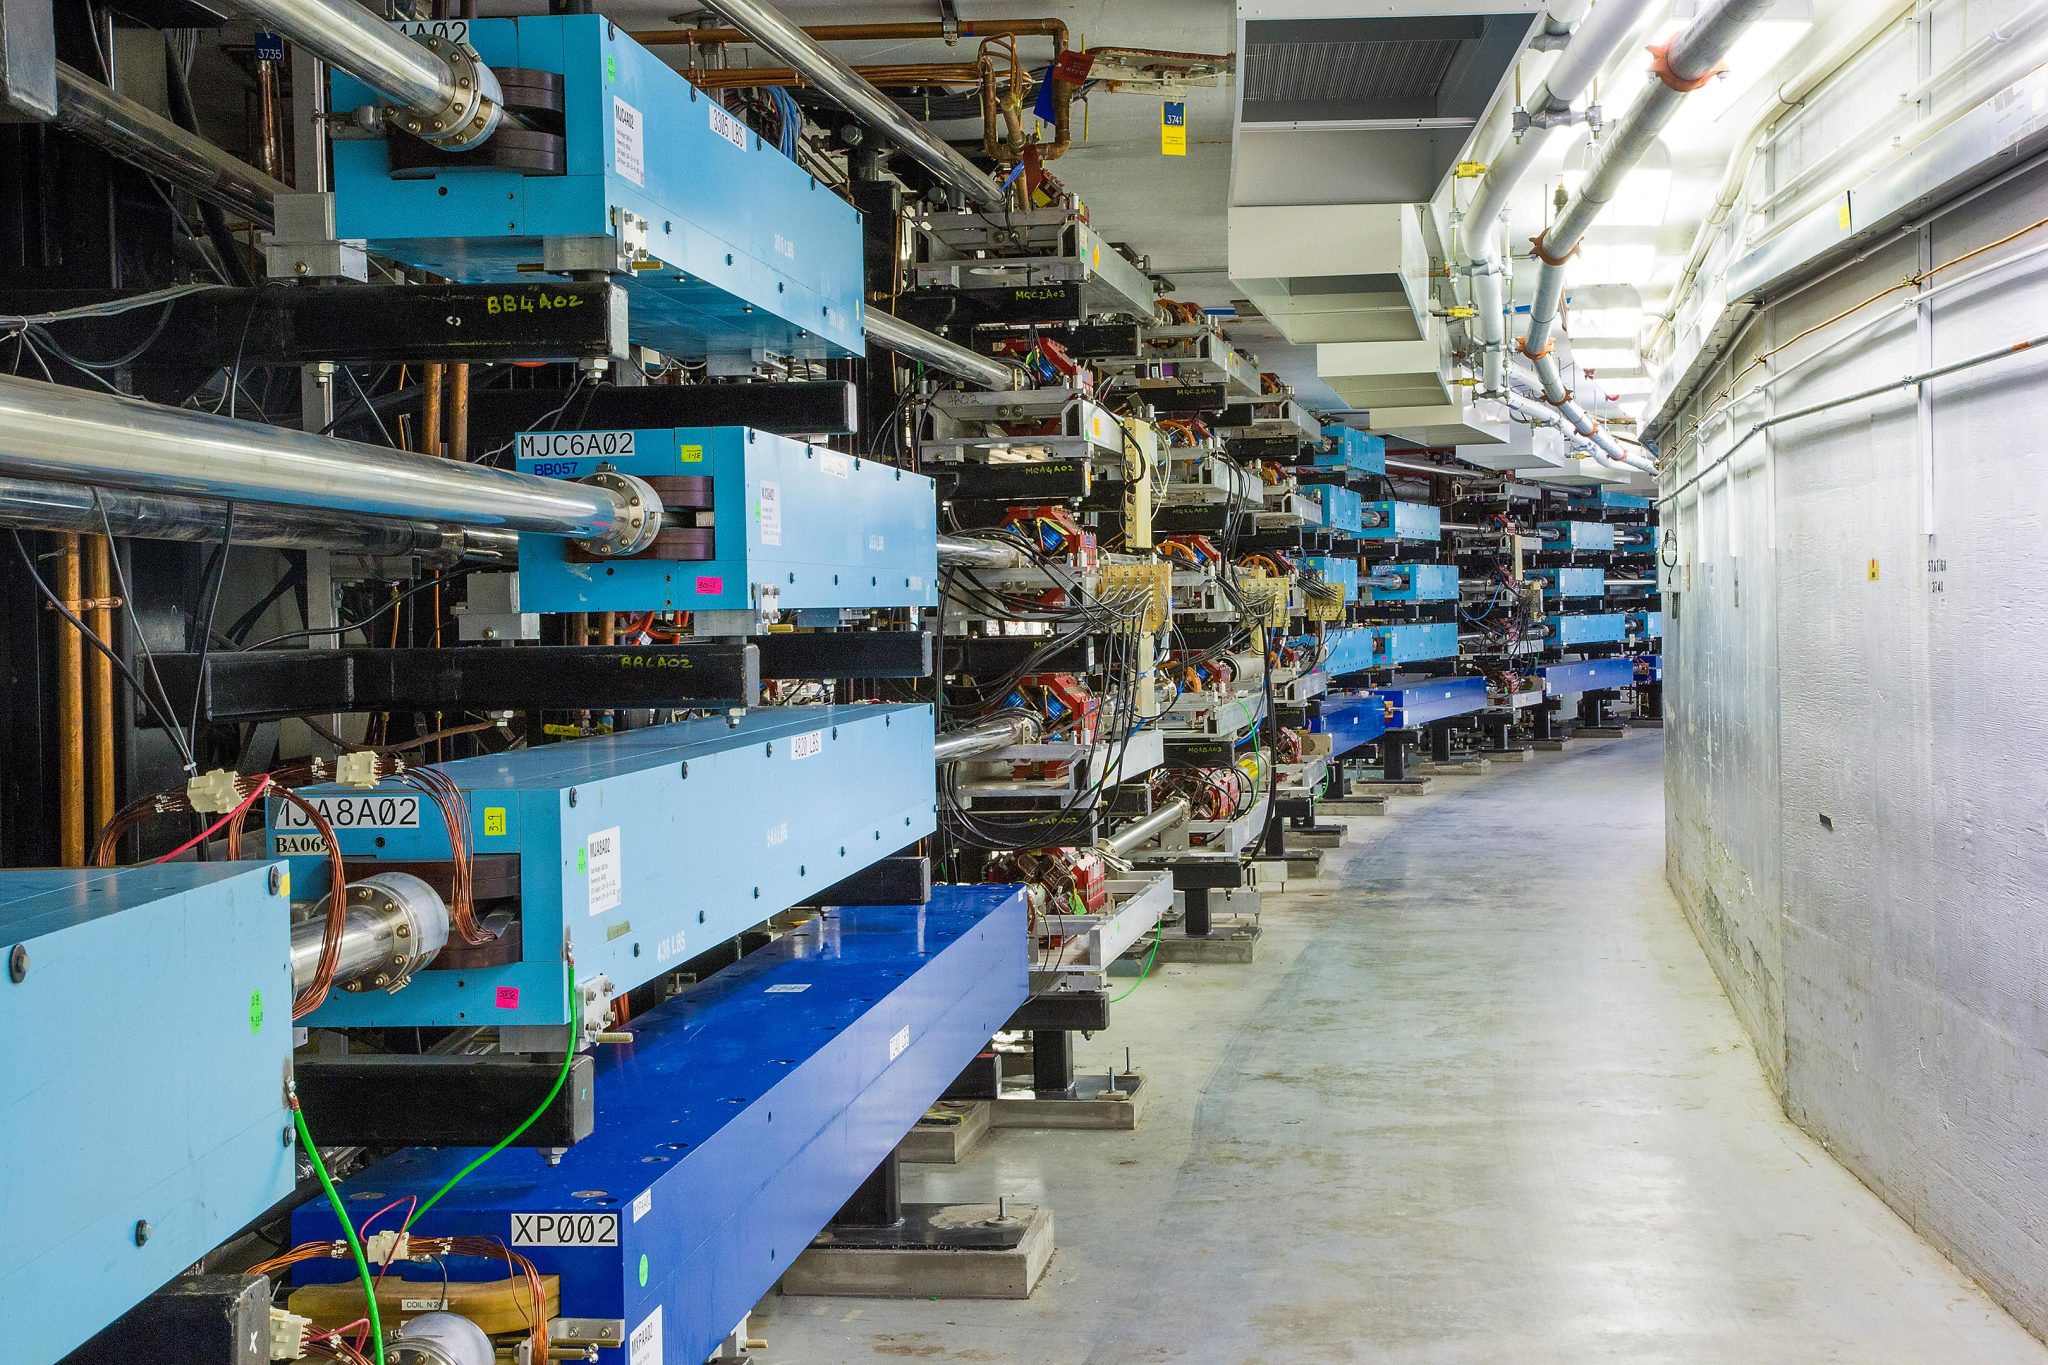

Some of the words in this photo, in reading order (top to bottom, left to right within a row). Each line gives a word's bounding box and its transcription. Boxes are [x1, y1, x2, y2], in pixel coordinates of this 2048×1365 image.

[258, 48, 282, 60] 3735
[1167, 114, 1182, 125] 3741
[732, 121, 744, 147] LBS
[487, 293, 584, 315] BB4A02
[534, 462, 579, 476] BB057
[406, 1301, 424, 1309] COIL
